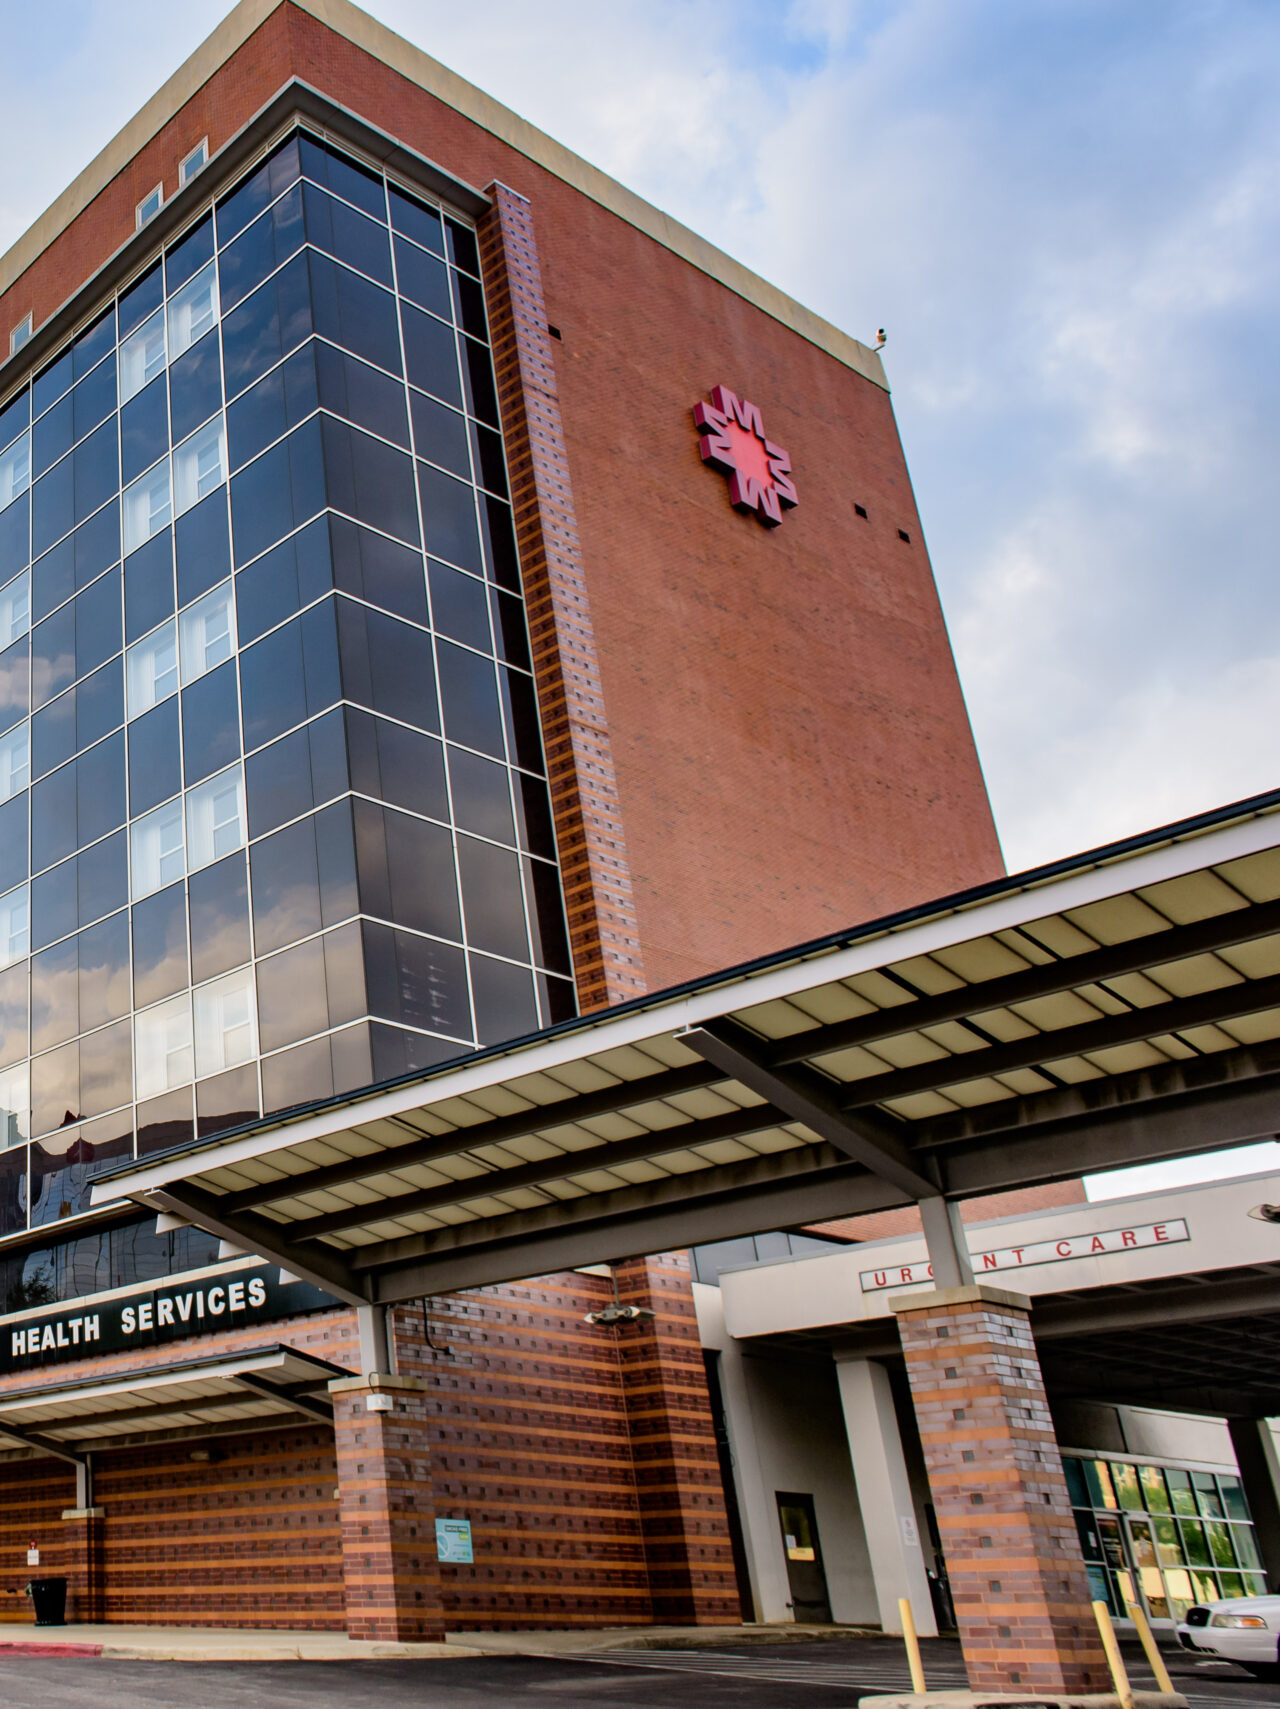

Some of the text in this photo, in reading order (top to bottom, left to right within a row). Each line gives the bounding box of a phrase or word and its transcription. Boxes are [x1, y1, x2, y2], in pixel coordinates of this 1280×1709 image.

[874, 1225, 1169, 1286] URNT CARE
[12, 1314, 100, 1357] HEALTH
[121, 1278, 267, 1334] SERVICES
